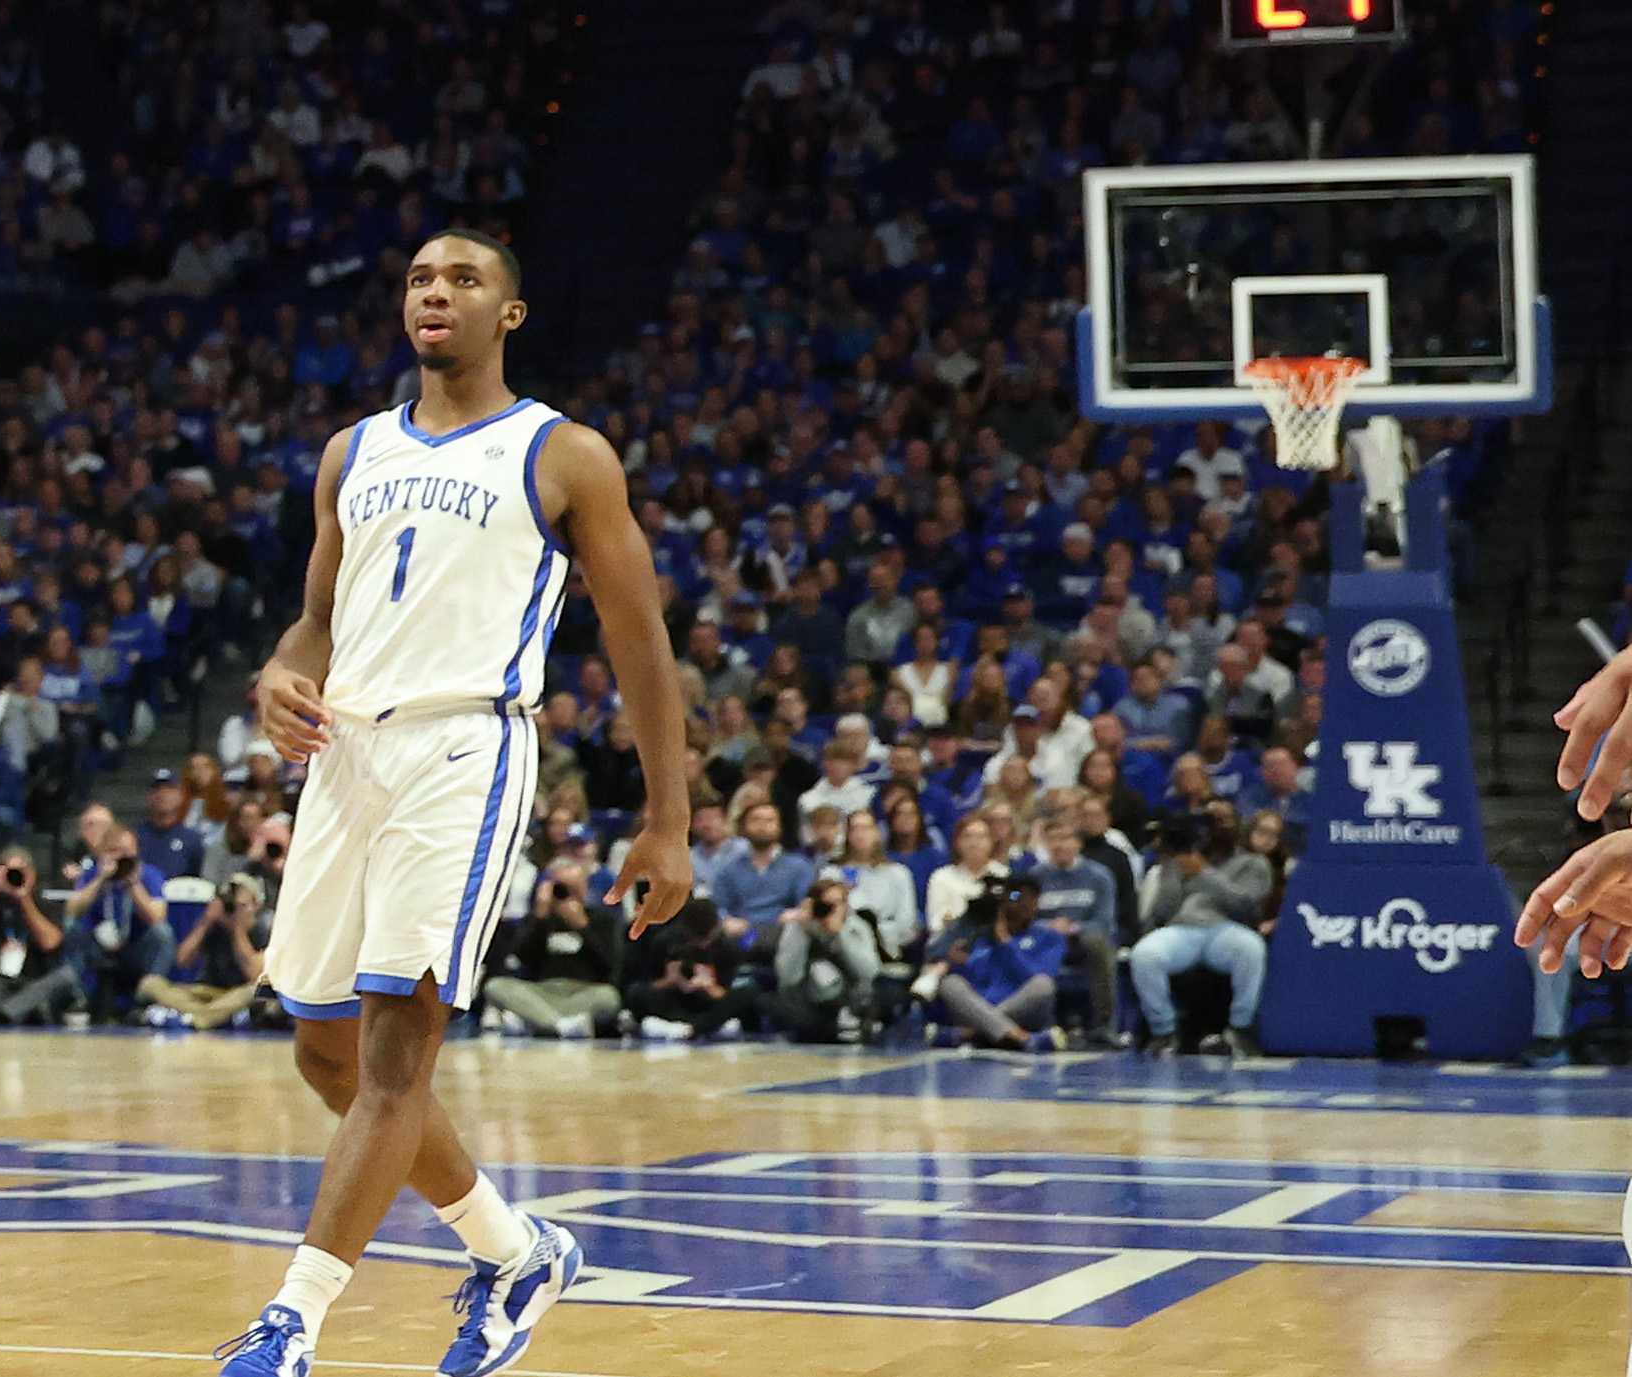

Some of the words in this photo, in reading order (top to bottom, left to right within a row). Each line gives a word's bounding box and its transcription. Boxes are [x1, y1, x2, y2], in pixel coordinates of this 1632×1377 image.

[349, 476, 499, 529] KENTUCKY
[391, 527, 416, 602] 1
[1342, 742, 1441, 817] UK
[1330, 818, 1461, 844] HealthCare
[1360, 897, 1499, 974] Kroger
